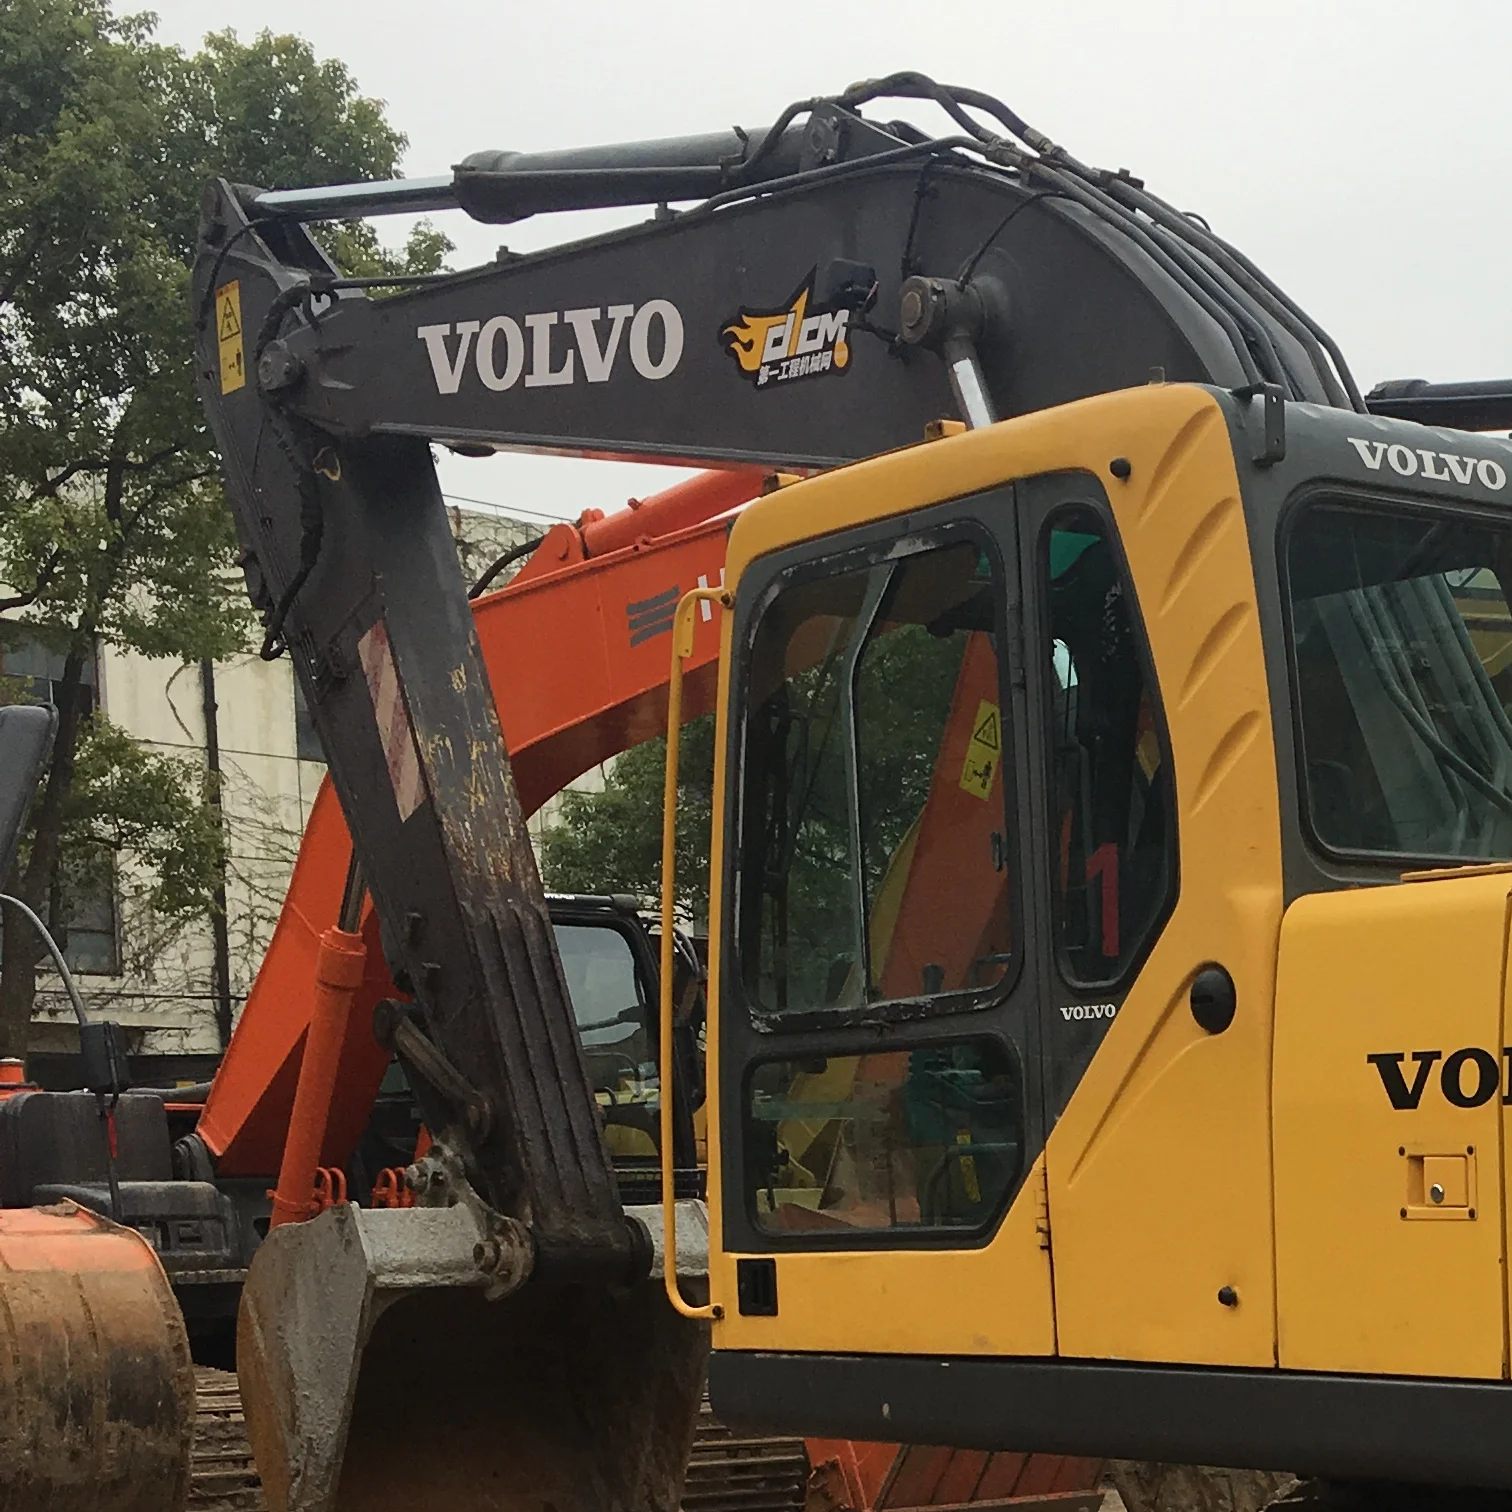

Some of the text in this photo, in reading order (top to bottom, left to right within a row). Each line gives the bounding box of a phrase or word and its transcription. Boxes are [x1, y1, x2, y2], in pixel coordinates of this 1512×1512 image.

[417, 299, 684, 394] VOLVO
[1347, 437, 1507, 490] VOLVO
[1059, 1003, 1116, 1020] VOLVO
